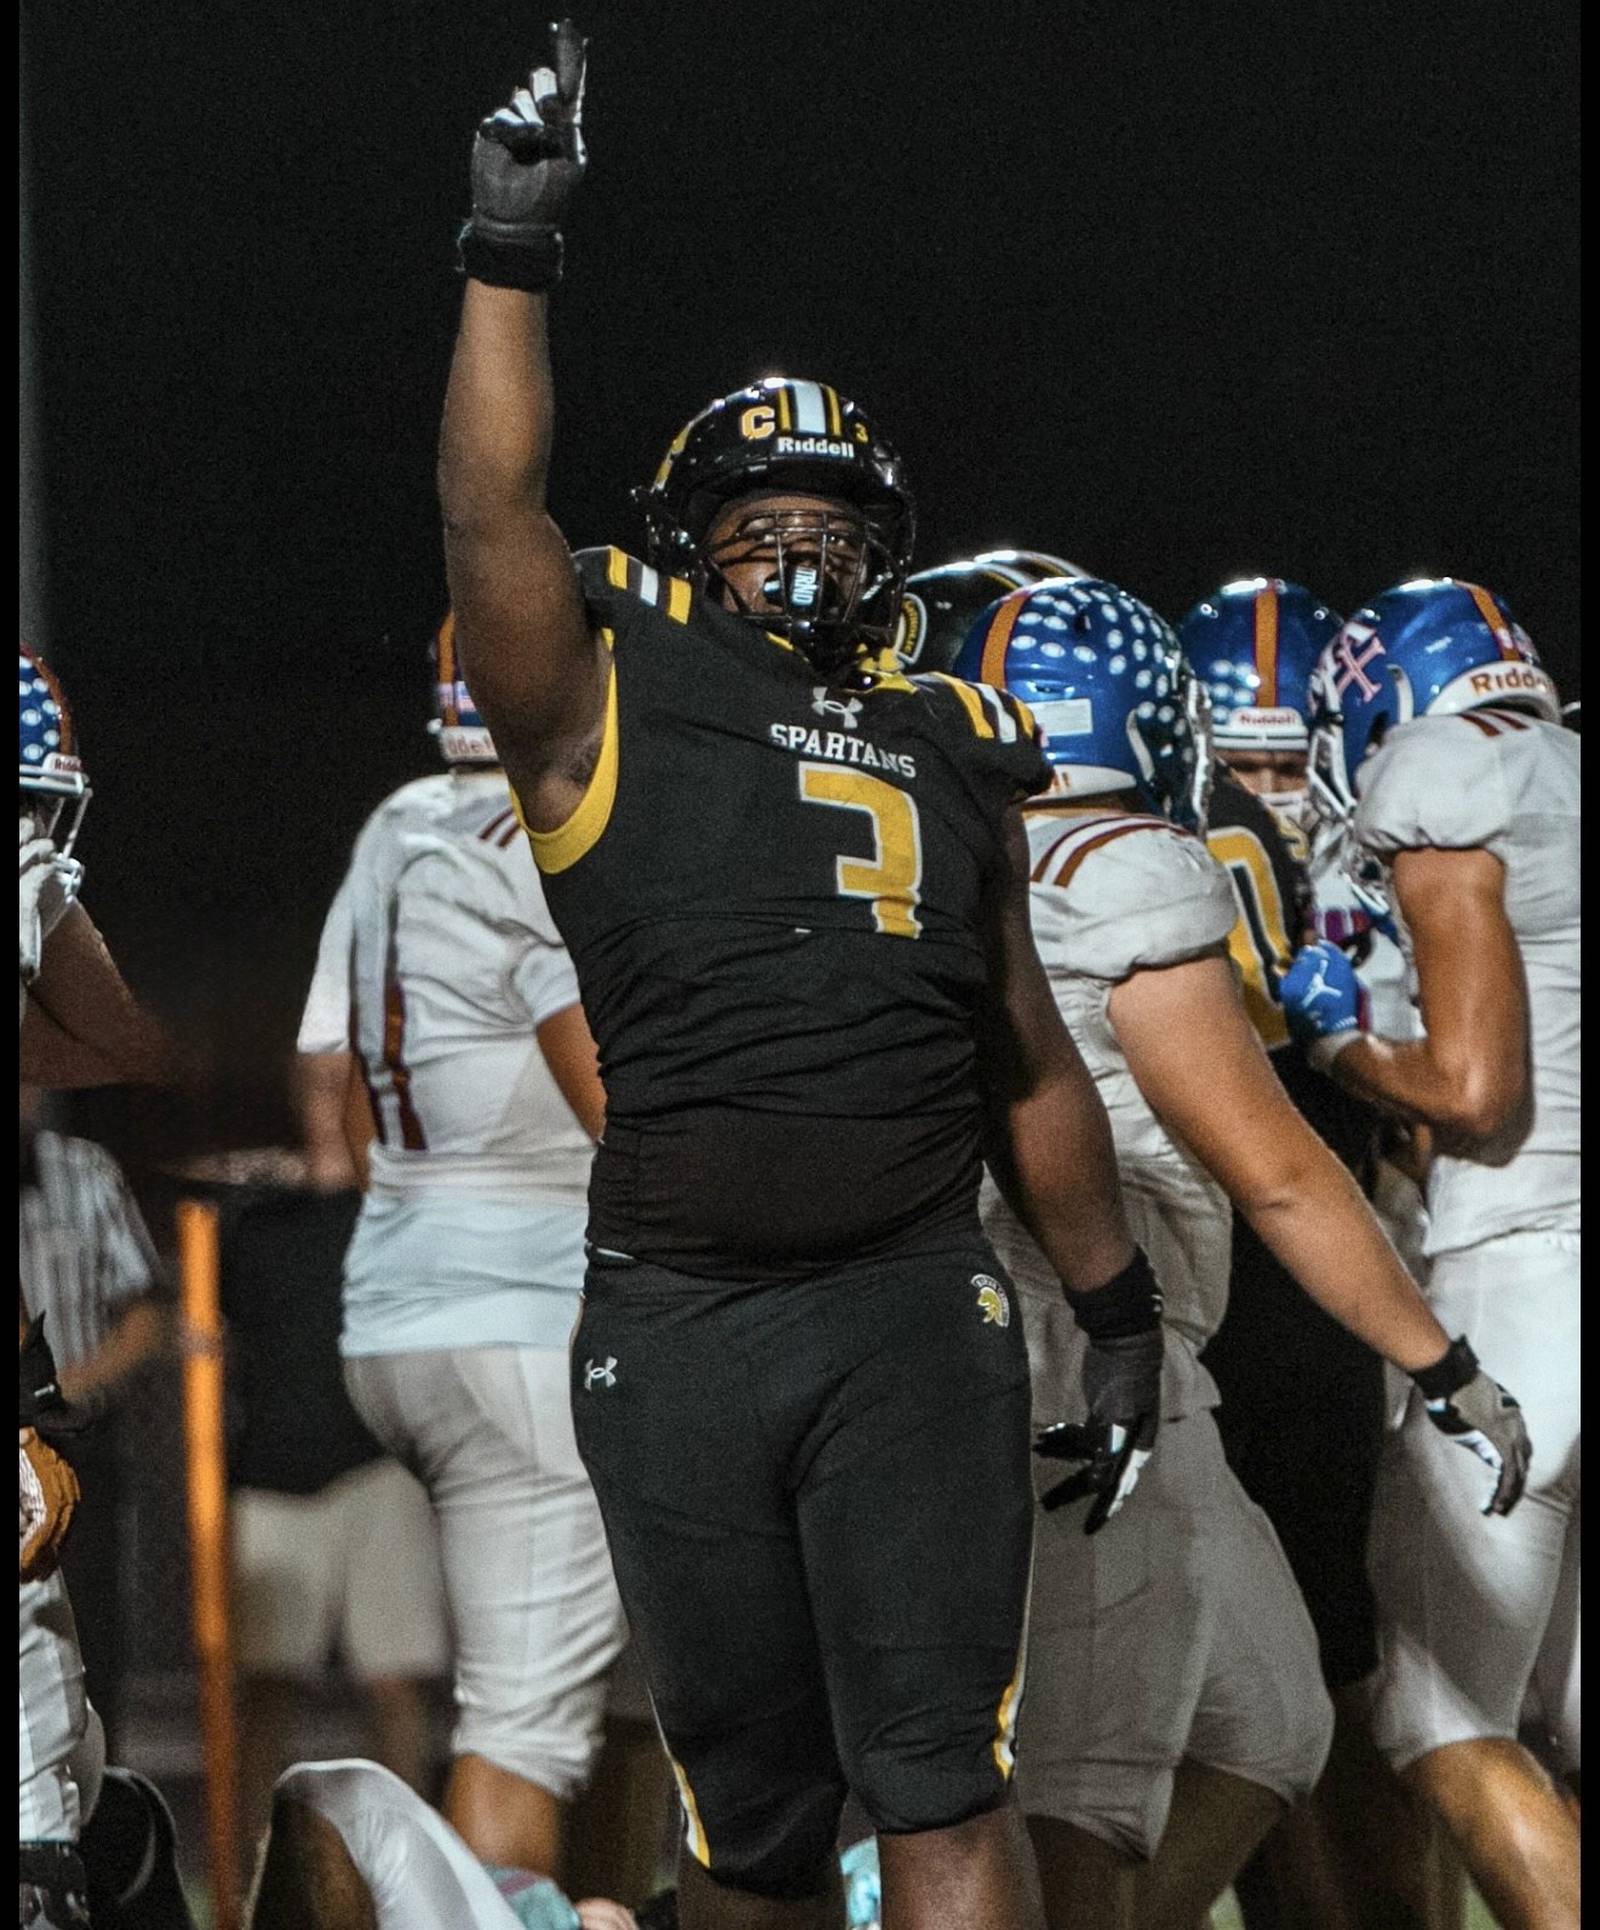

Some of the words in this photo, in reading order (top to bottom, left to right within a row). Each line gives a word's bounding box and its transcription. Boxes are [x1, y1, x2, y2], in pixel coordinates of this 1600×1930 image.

[741, 405, 775, 440] C
[776, 436, 855, 459] Riddell
[1470, 667, 1553, 697] Ridd
[770, 722, 916, 779] SPARTANS
